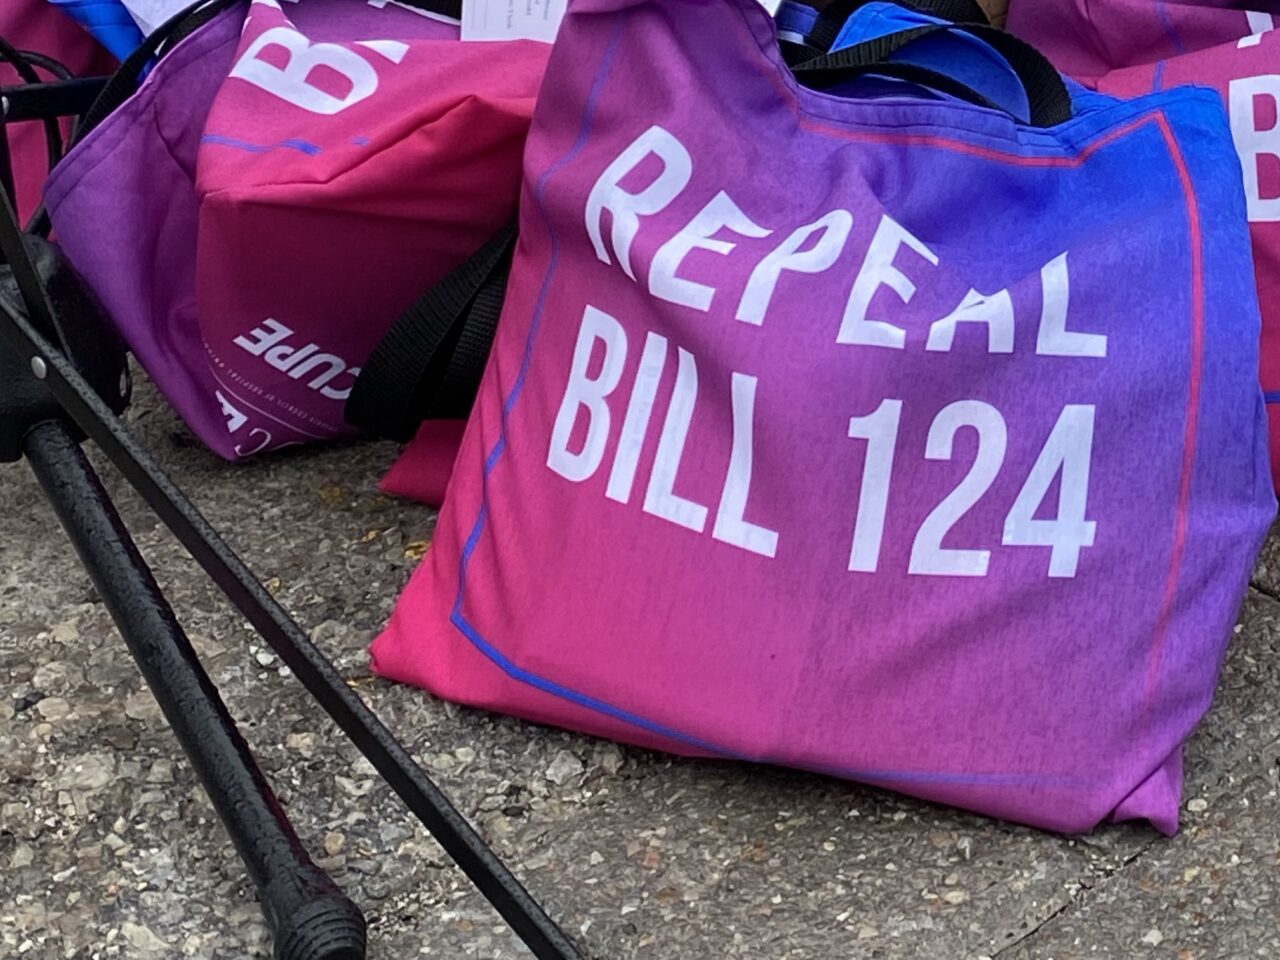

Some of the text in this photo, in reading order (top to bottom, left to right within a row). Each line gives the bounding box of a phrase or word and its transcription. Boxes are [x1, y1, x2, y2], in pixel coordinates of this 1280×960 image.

[585, 125, 1108, 358] REPEAL
[233, 318, 360, 399] CUPE
[546, 305, 1097, 578] BILL 124
